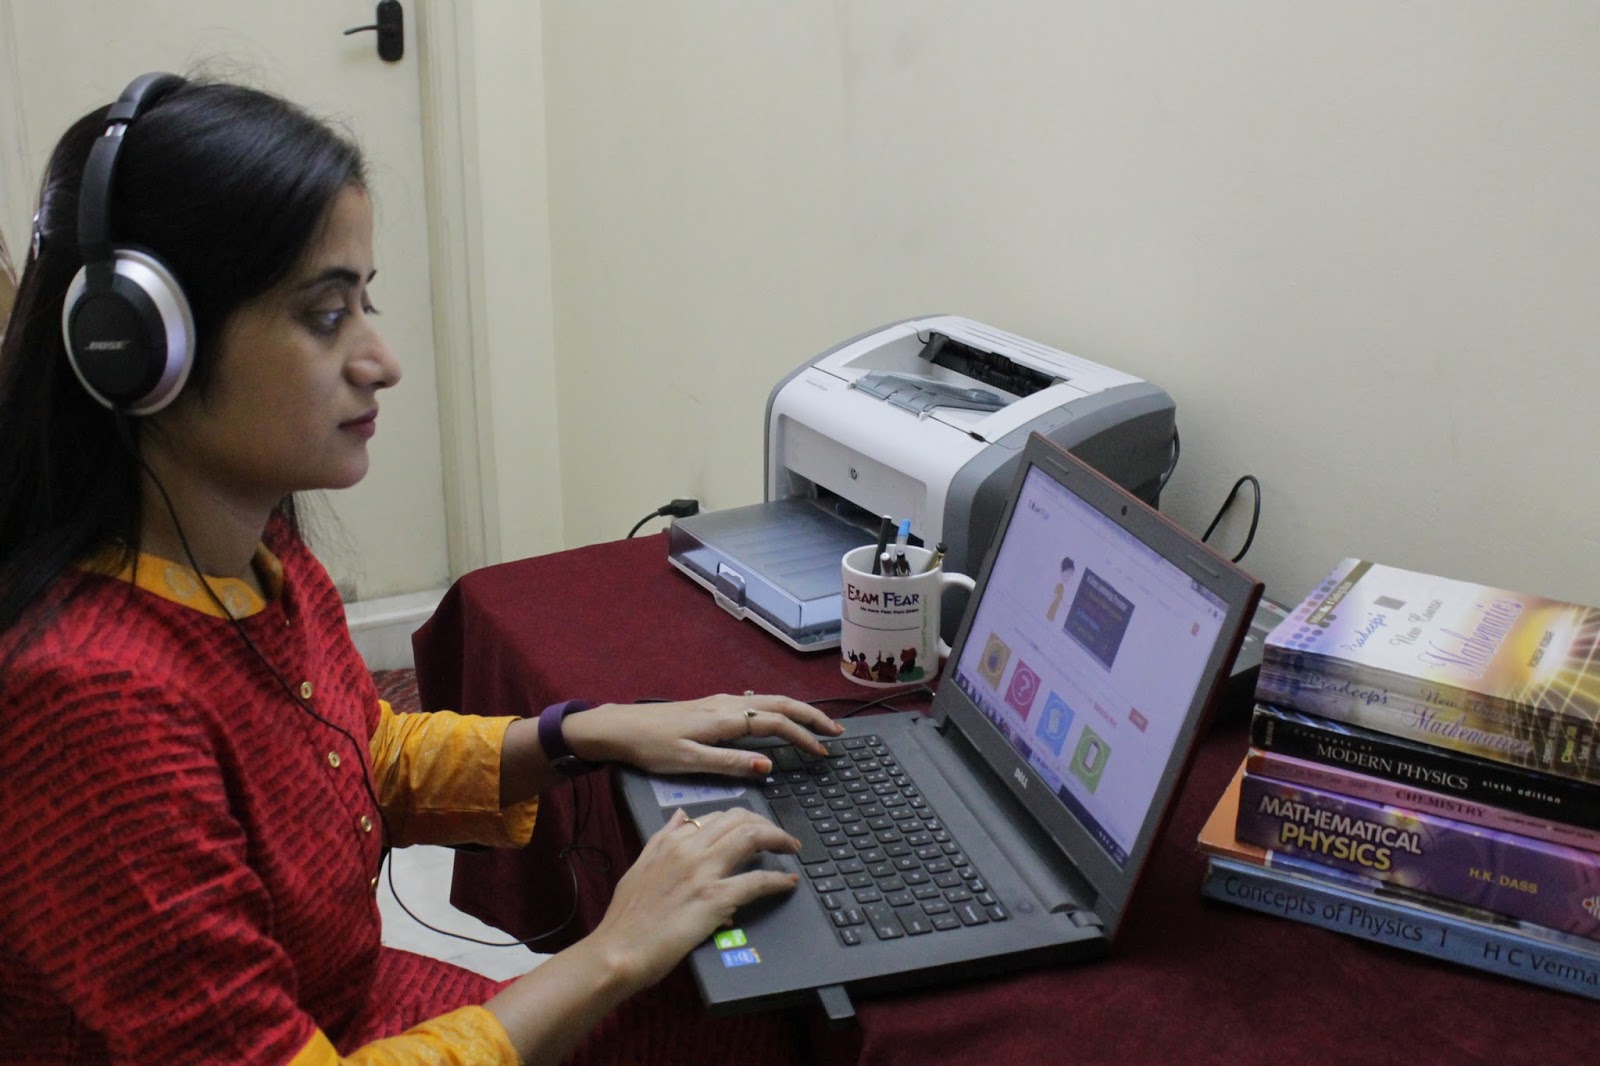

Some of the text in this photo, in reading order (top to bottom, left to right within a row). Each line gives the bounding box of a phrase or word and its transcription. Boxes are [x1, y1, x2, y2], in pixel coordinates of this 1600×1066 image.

[882, 592, 920, 608] FEAR
[1316, 743, 1393, 773] MODERN
[1397, 762, 1469, 790] PHYSICS
[1395, 789, 1486, 818] CHEMISTRY
[1482, 779, 1561, 805] sixth edition
[1259, 795, 1422, 855] MATHEMATICAL
[1281, 822, 1392, 871] PHYSICS
[1499, 874, 1538, 894] DASS
[1224, 876, 1316, 915] Concepts
[1322, 902, 1346, 921] of
[1349, 907, 1423, 941] Physics
[1483, 942, 1501, 961] H
[1508, 949, 1522, 967] C
[1531, 953, 1599, 986] Verma
